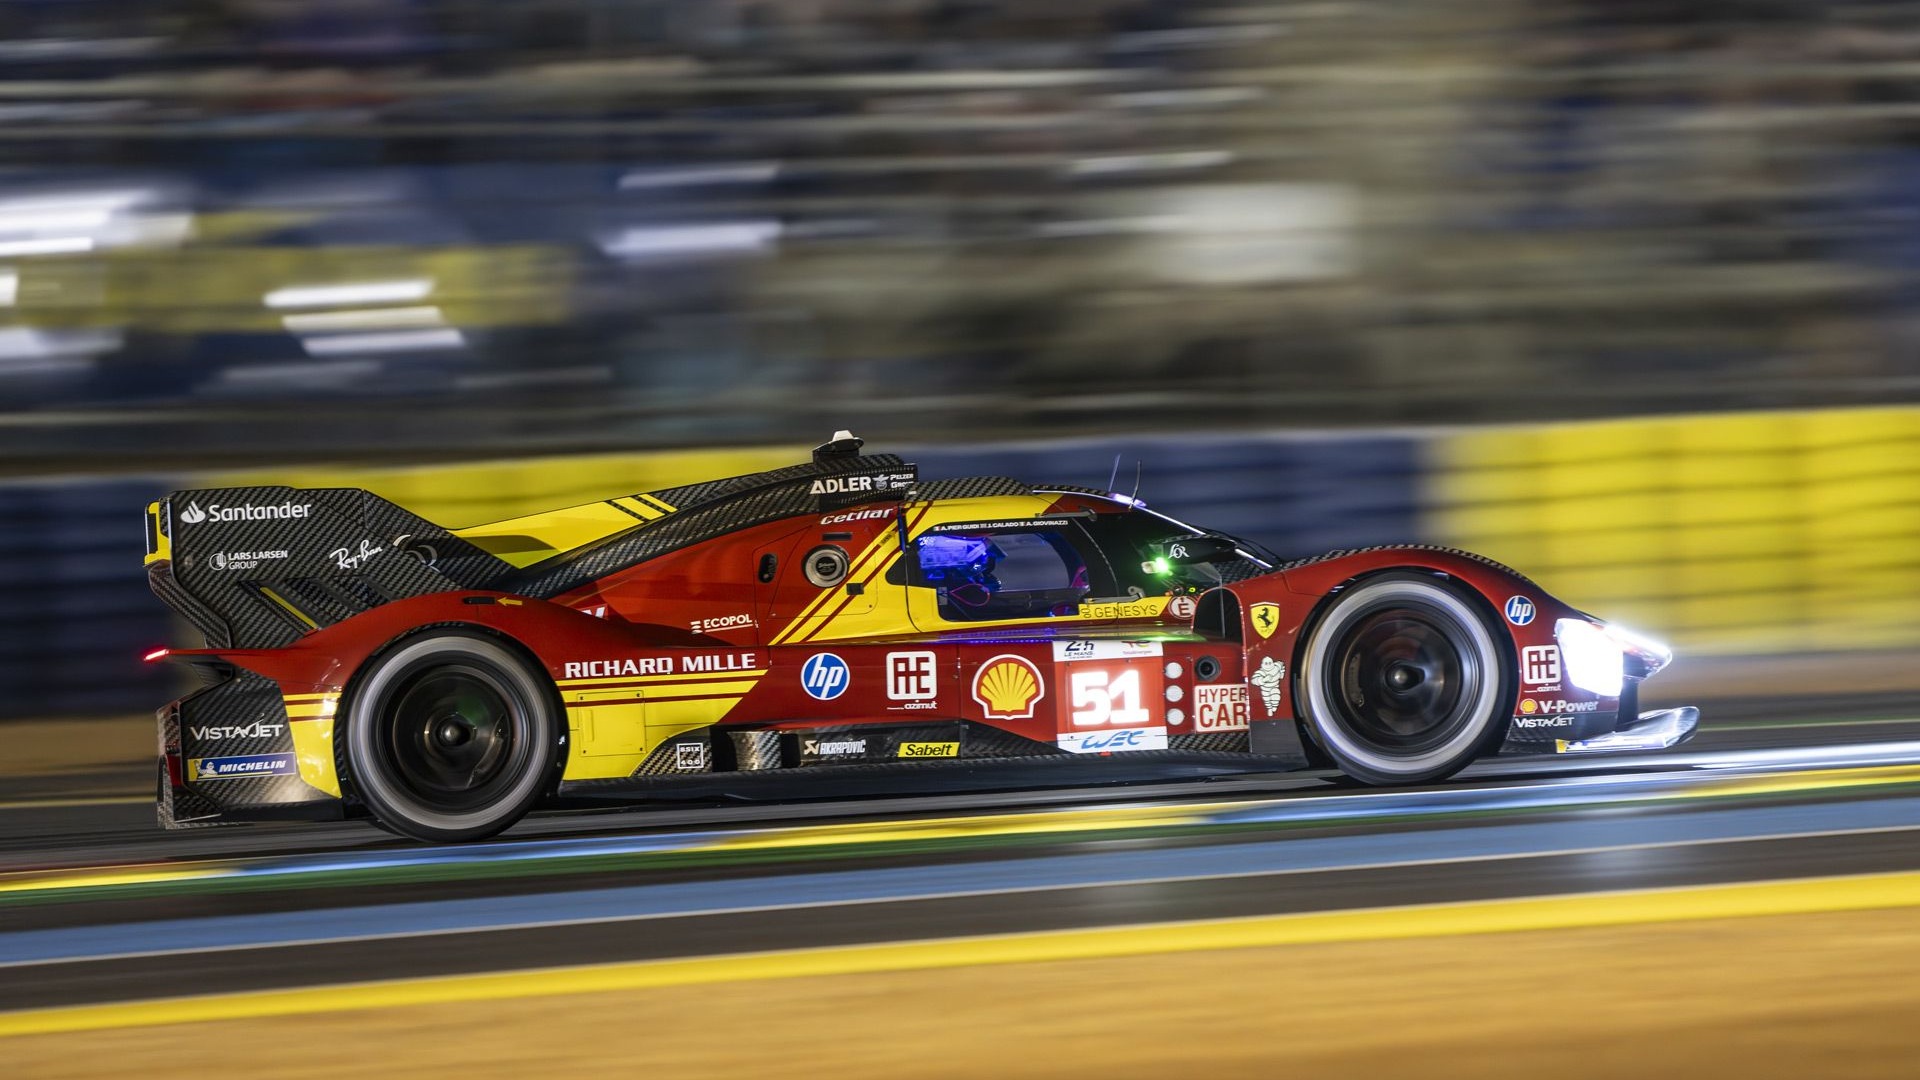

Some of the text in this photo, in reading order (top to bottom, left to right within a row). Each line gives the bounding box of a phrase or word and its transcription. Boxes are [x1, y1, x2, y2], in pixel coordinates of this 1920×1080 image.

[810, 476, 872, 494] ADLER
[208, 501, 312, 523] Santander
[228, 550, 288, 561] LARS LARSEN
[329, 539, 383, 570] Ray-Ban
[228, 561, 258, 570] GROUP
[1095, 604, 1158, 618] GENESYS
[1510, 595, 1532, 625] hp
[703, 613, 752, 629] ECOPOL
[565, 653, 757, 679] RICHARD MILLE
[808, 653, 845, 699] hp
[1071, 669, 1150, 726] 51
[1198, 687, 1247, 703] HYPER
[904, 699, 937, 710] azimut
[1539, 699, 1599, 714] V-Power
[1199, 703, 1248, 728] CAR
[1081, 731, 1144, 750] WEC
[905, 743, 952, 756] Sabelt
[218, 760, 287, 773] MICHELIN
